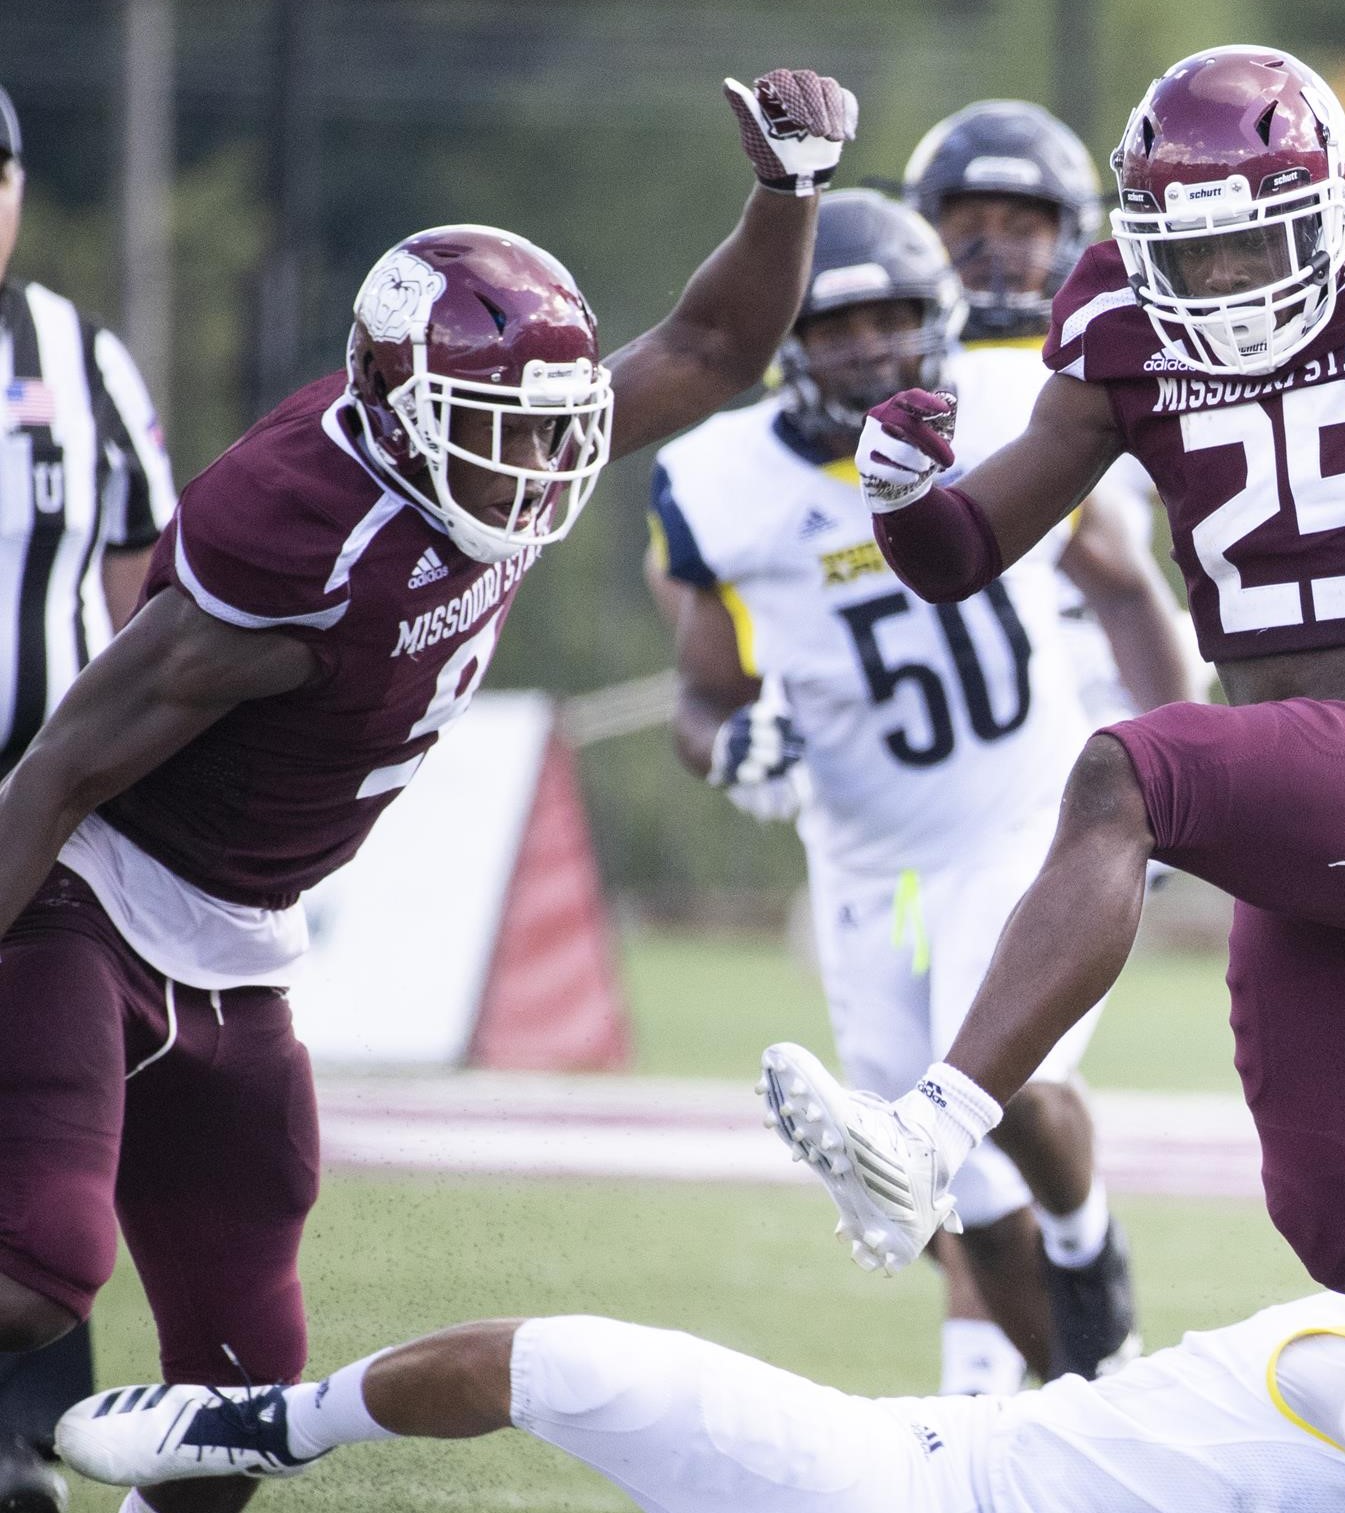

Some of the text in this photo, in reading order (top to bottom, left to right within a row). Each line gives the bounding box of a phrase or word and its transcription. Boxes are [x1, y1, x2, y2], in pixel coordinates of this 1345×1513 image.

[1273, 171, 1298, 186] schutt
[1127, 193, 1144, 203] schutt
[1189, 187, 1222, 200] schutt
[1238, 342, 1268, 352] chutt
[35, 460, 63, 514] U
[408, 565, 450, 590] adidas
[390, 560, 503, 657] MISSOURI
[835, 577, 1032, 769] 50
